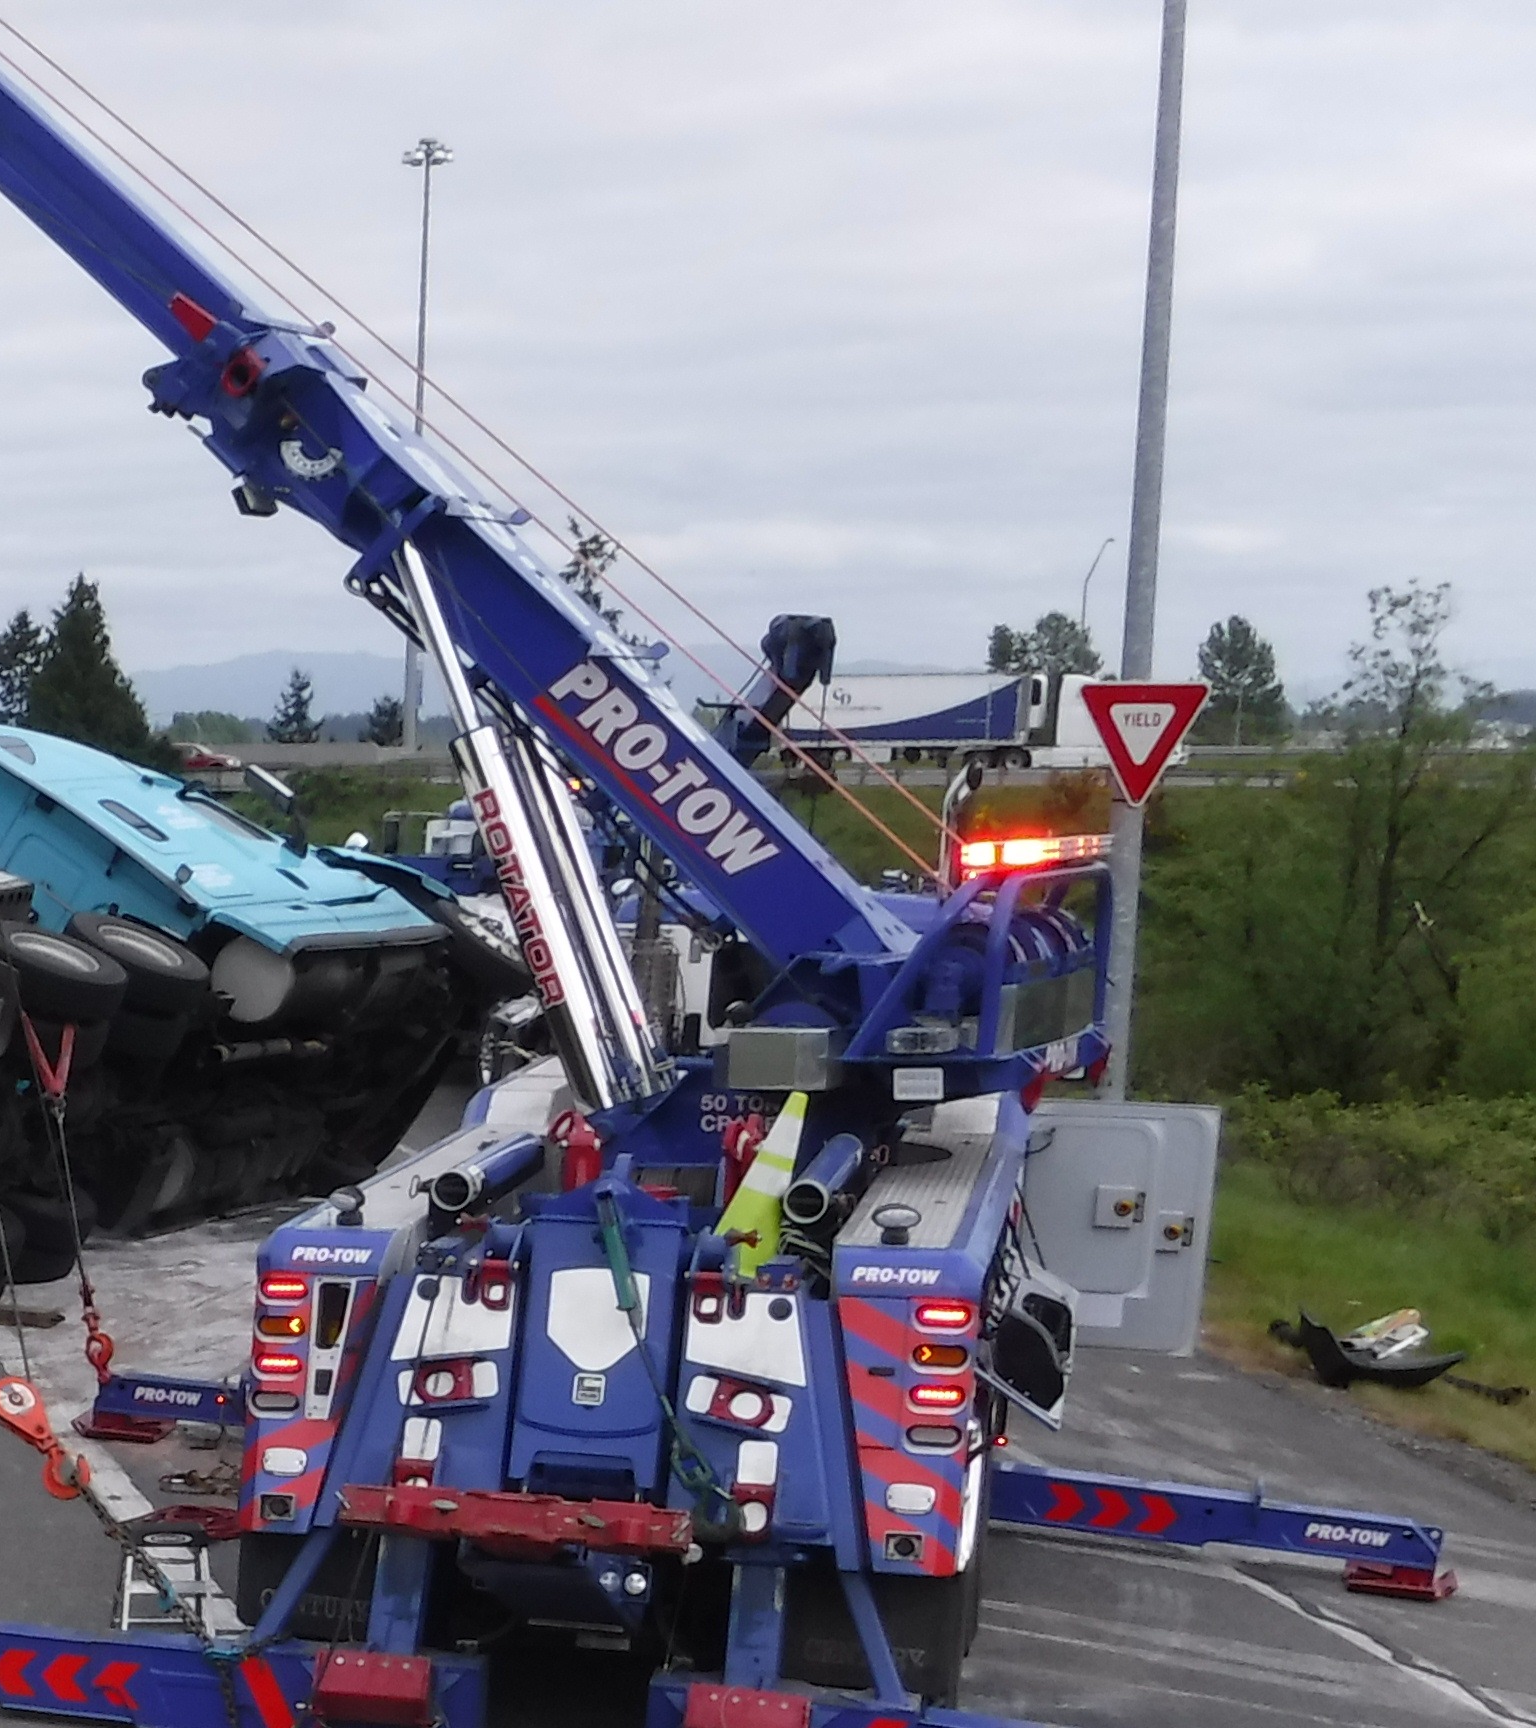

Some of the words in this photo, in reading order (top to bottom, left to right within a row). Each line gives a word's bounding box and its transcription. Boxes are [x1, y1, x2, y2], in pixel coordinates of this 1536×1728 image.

[1123, 712, 1161, 727] YIELD
[548, 659, 780, 875] PRO-TOW
[472, 786, 566, 1007] ROTATOR
[700, 1094, 728, 1112] 50
[291, 1246, 373, 1264] PRO-TOW
[852, 1265, 942, 1285] PRO-TOW
[133, 1386, 203, 1407] PRO-TOW
[1304, 1522, 1391, 1547] PRO-TOW
